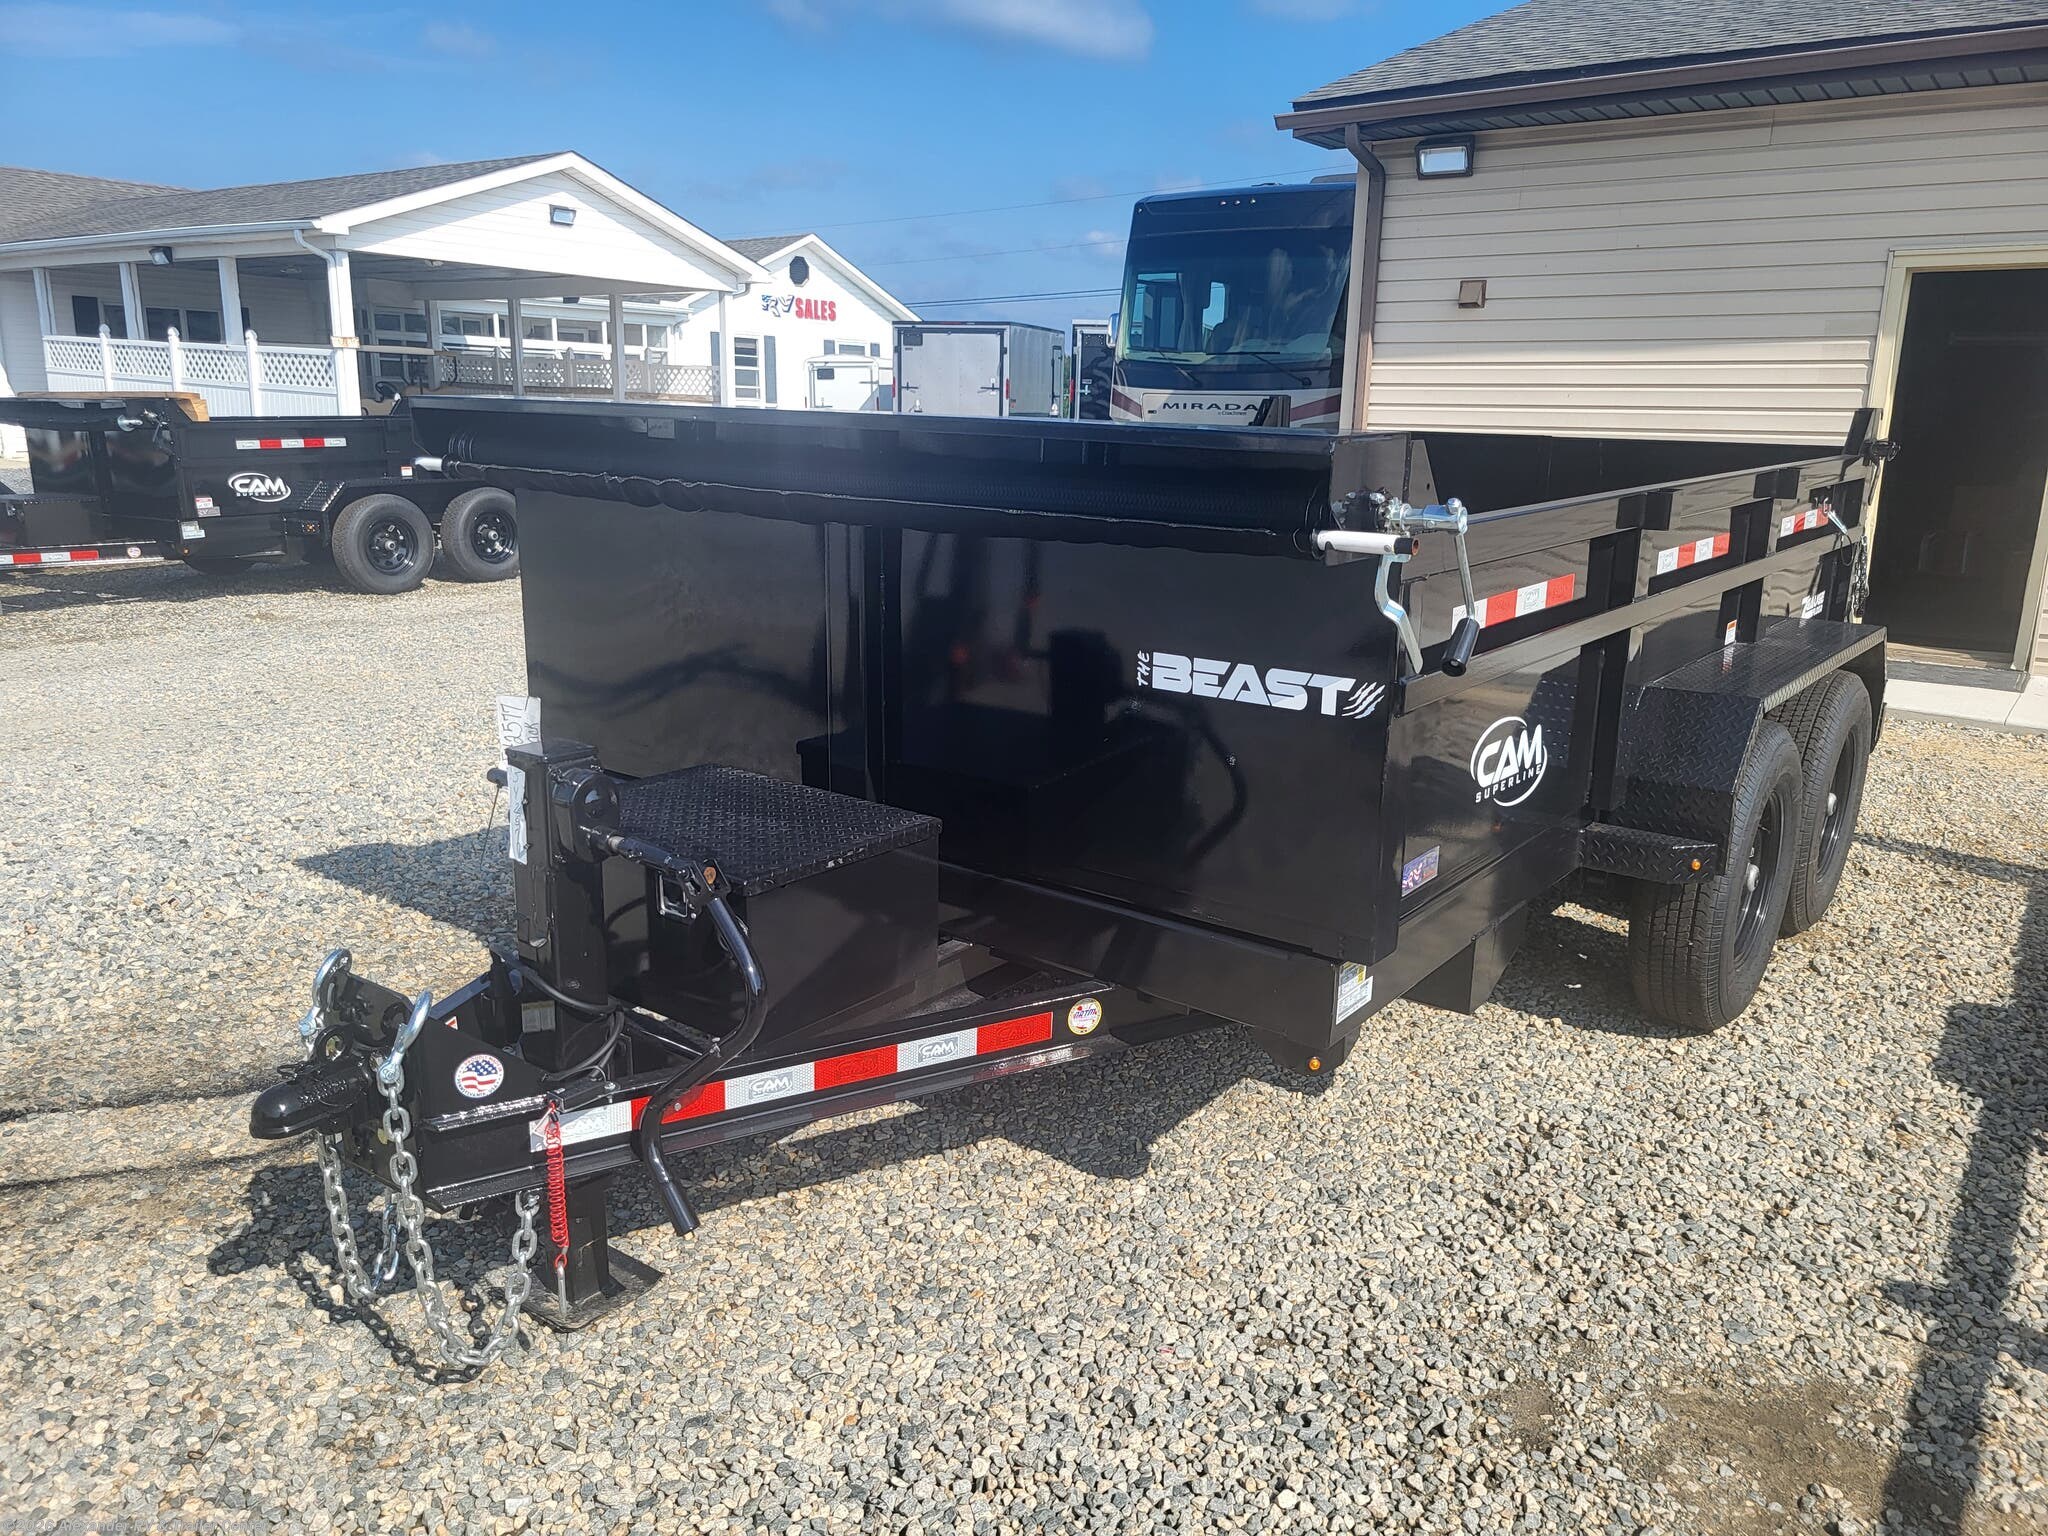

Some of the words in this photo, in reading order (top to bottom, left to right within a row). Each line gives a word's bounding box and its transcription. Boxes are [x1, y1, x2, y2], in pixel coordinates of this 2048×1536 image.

[795, 297, 837, 321] SALES
[1162, 402, 1259, 411] MIRADA
[233, 477, 286, 493] CAM
[1136, 650, 1150, 687] THE
[1152, 652, 1357, 717] BEAST
[1477, 723, 1542, 788] CAM
[1475, 764, 1542, 804] SUPERLINE
[921, 1041, 955, 1057] CAM
[752, 1076, 789, 1093] CAM
